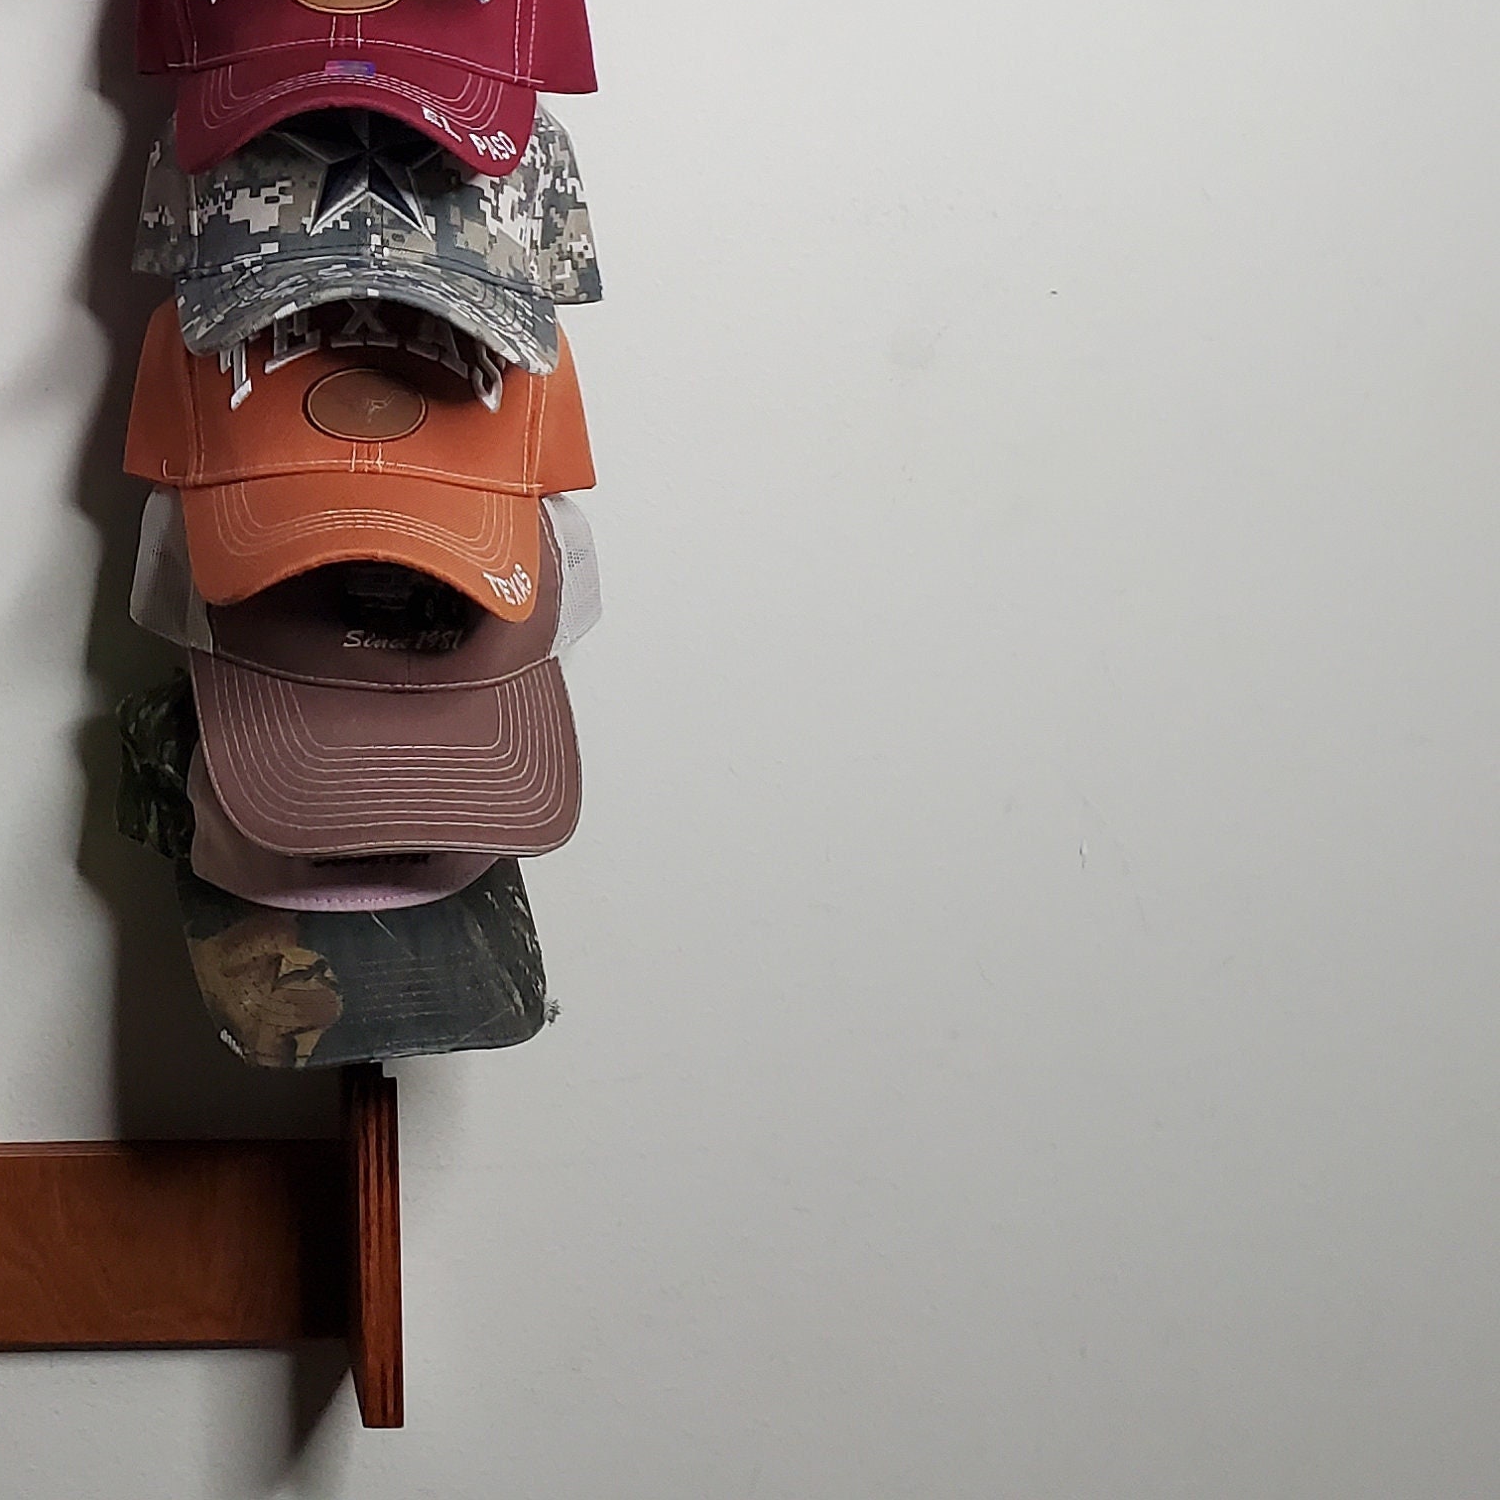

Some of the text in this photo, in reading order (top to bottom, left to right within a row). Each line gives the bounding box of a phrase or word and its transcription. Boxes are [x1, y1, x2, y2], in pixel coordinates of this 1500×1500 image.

[421, 106, 518, 161] EL PASO
[482, 563, 532, 605] TEXAS
